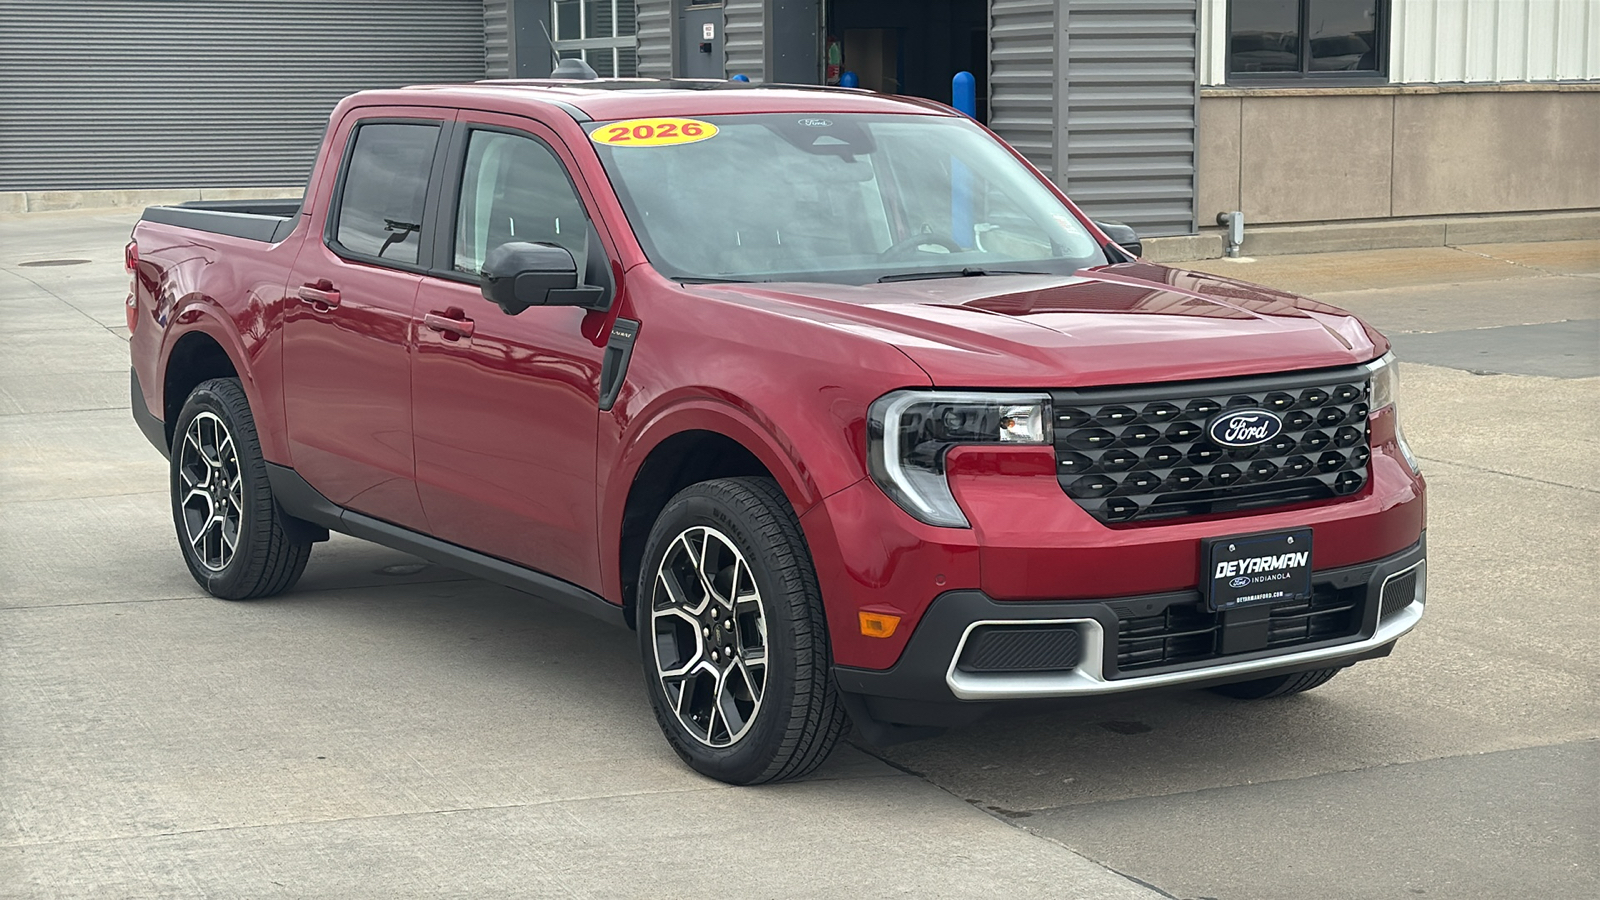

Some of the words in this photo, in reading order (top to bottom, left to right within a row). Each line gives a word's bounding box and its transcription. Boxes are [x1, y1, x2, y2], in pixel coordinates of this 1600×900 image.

[608, 123, 703, 142] 2026
[1225, 416, 1269, 441] Ford
[1215, 552, 1309, 579] DEYARMAN
[1251, 572, 1291, 583] INDIANOLA
[1236, 591, 1284, 603] DEYARMANFORD.COM
